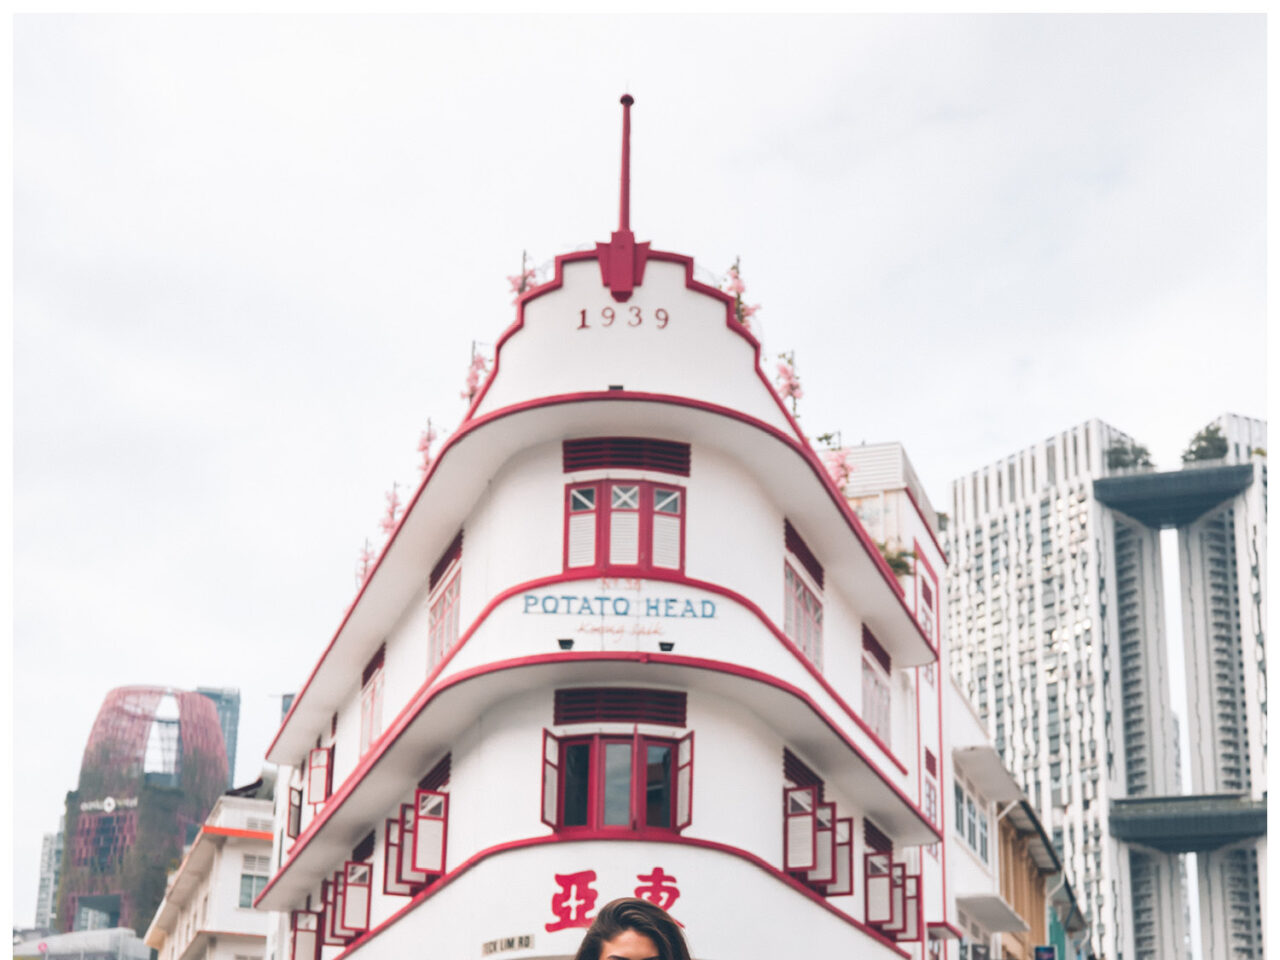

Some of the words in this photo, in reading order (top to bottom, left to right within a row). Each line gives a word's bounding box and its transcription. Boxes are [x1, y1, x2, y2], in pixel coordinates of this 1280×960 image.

[577, 305, 670, 330] 1939
[523, 594, 630, 617] POTATO
[645, 597, 716, 618] HEAD
